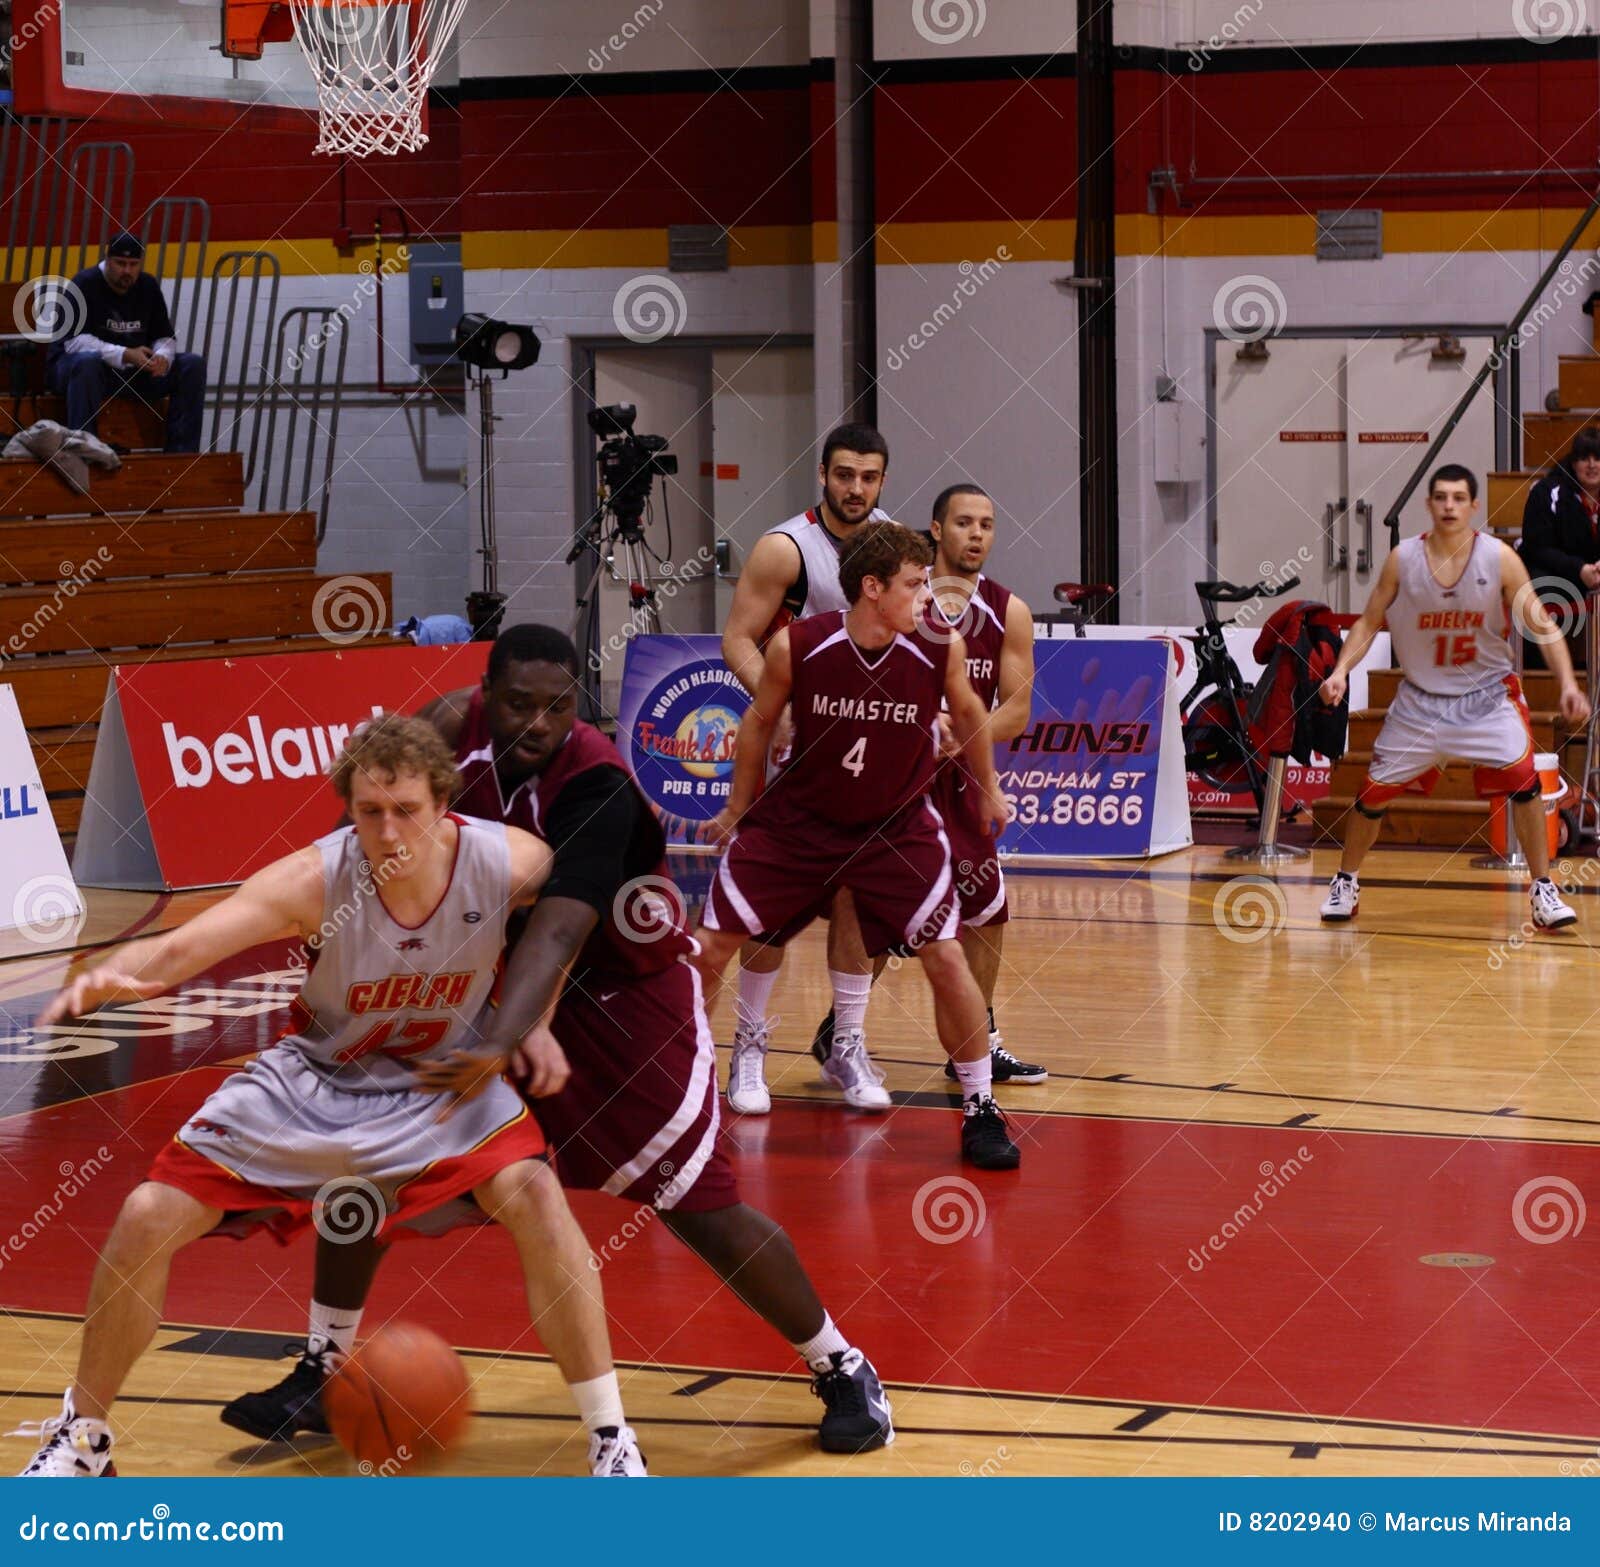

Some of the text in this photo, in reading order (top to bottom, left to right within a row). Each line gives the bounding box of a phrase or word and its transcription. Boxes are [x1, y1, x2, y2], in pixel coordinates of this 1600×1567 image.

[1418, 609, 1484, 630] GUELPH
[1434, 635, 1477, 668] 15
[652, 669, 755, 720] WORLD HEADQU
[812, 694, 919, 724] McMASTER
[162, 705, 384, 789] belair
[638, 721, 737, 761] Frank & S
[841, 737, 868, 777] 4
[662, 780, 732, 796] PUB & GR
[1110, 772, 1146, 790] ST
[0, 784, 38, 819] LL
